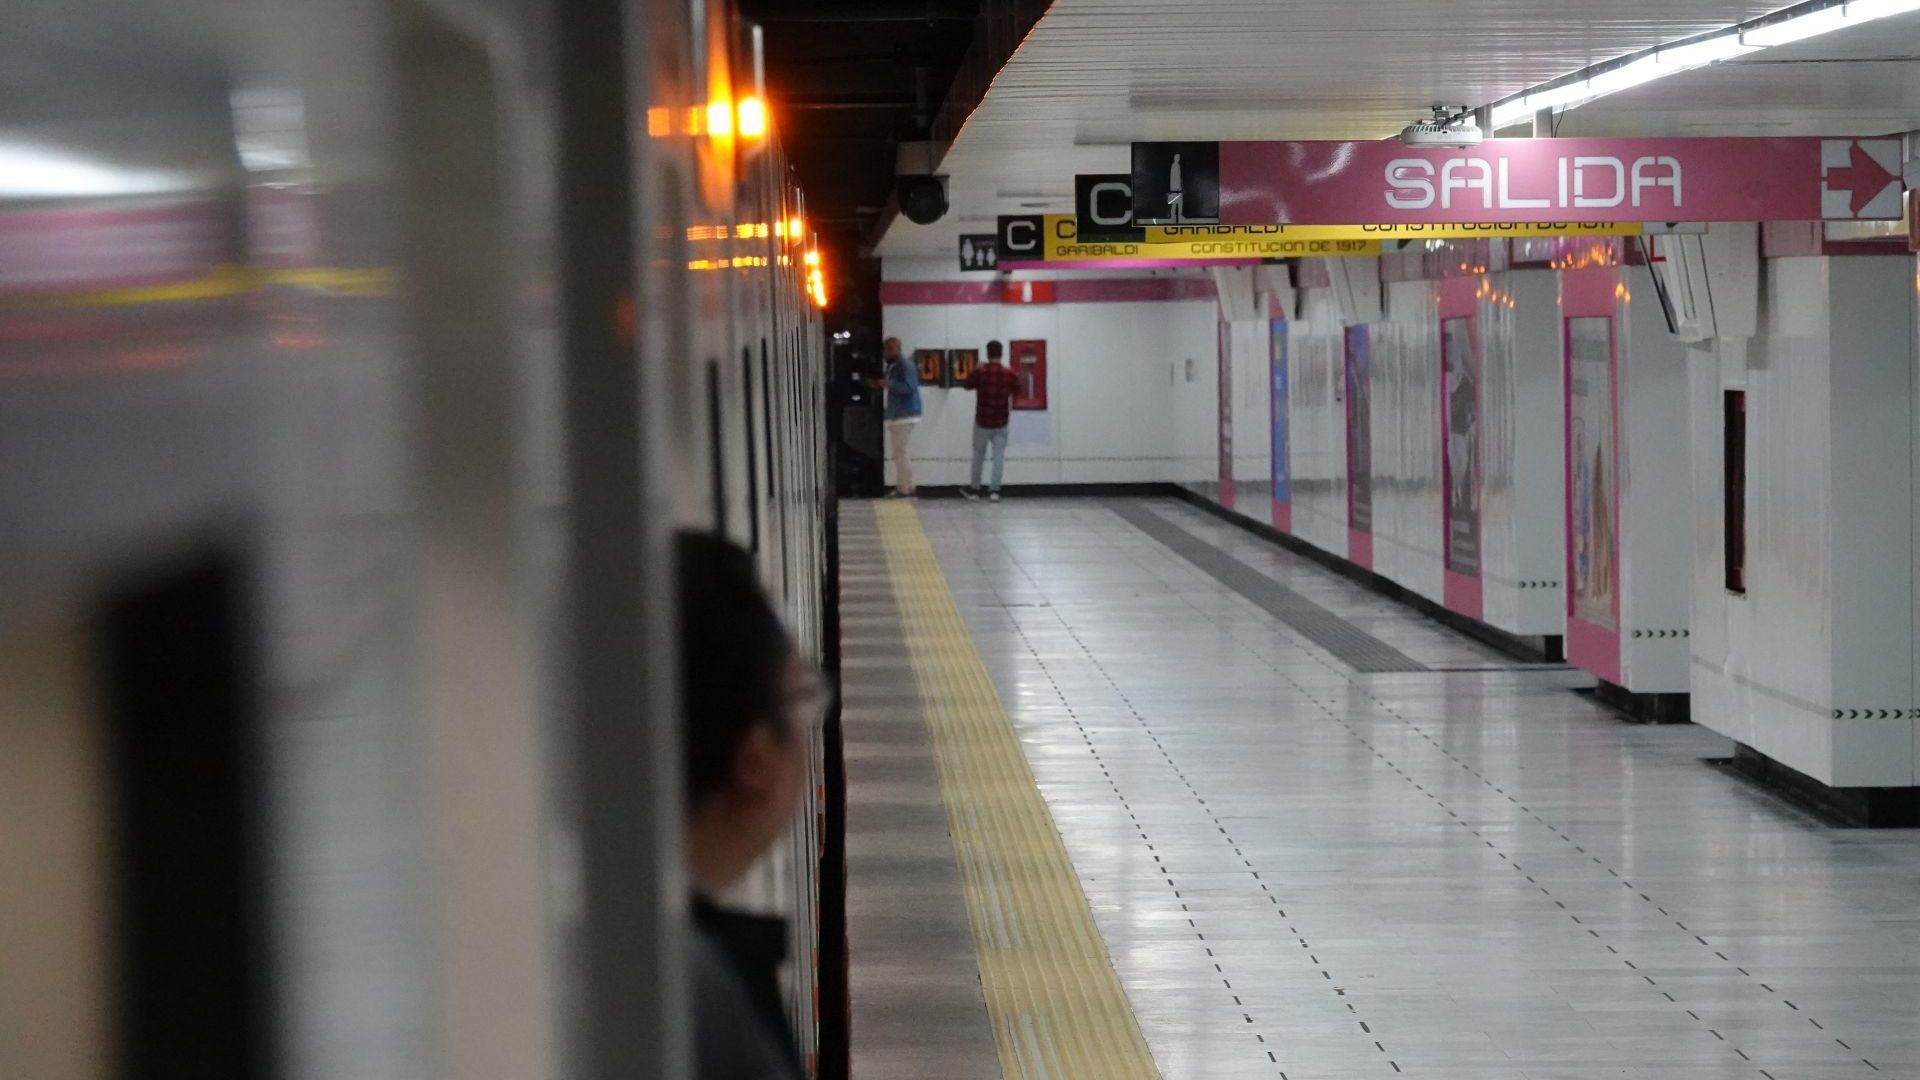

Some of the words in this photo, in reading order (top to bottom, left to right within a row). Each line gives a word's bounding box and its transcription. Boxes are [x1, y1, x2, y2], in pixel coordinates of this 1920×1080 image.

[1384, 156, 1682, 209] SALIDA
[1090, 182, 1132, 226] C
[1007, 220, 1036, 251] C
[1056, 245, 1139, 257] GARIBALDI
[1309, 240, 1330, 252] DE
[1336, 240, 1367, 252] 1917
